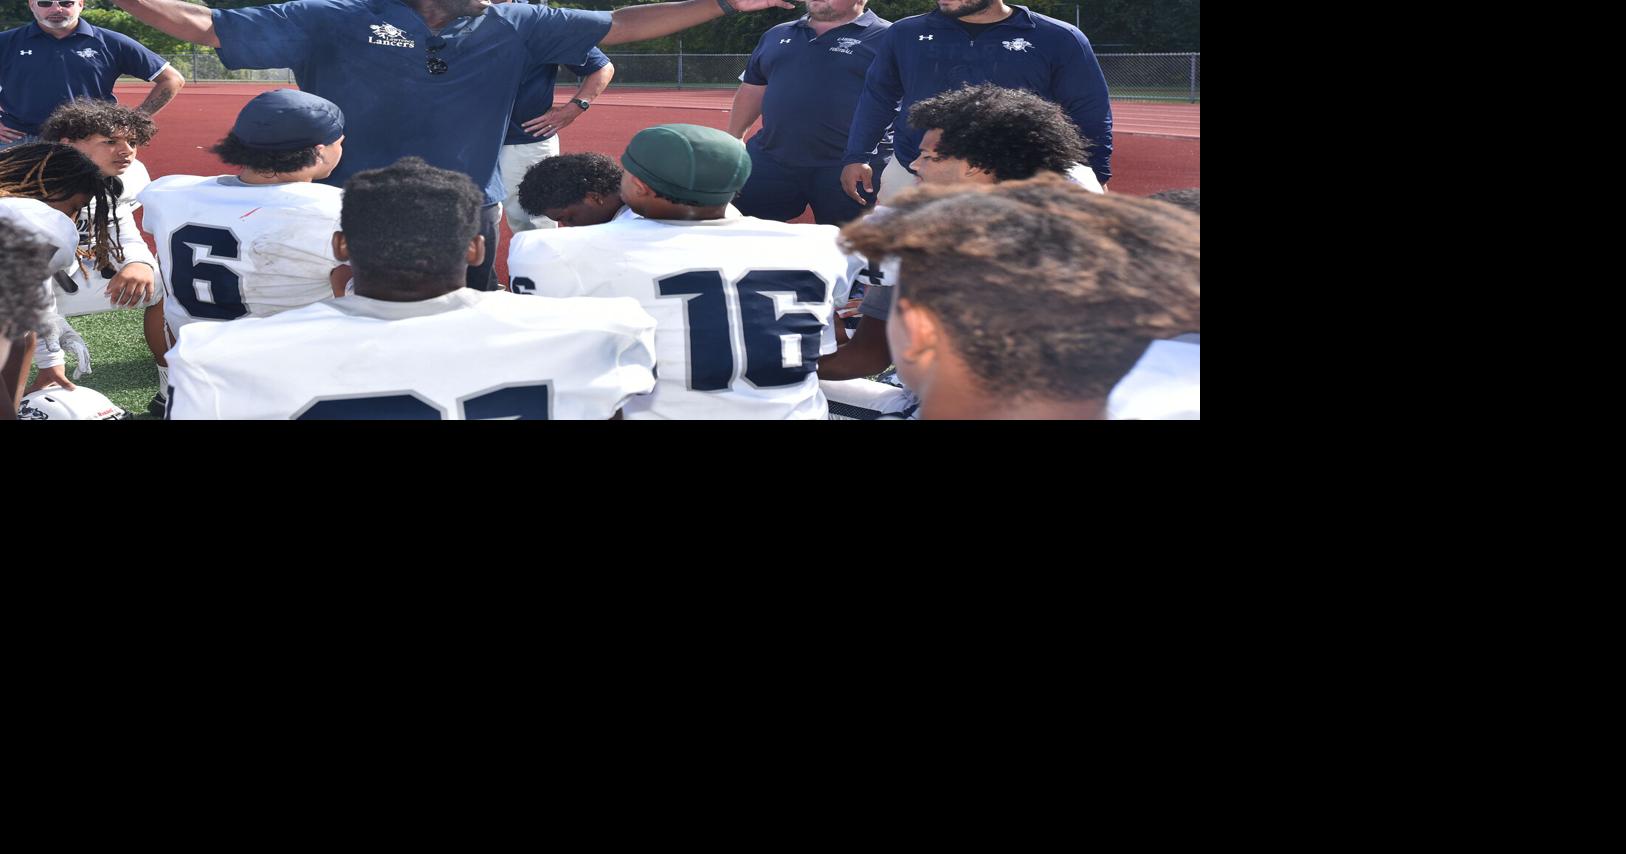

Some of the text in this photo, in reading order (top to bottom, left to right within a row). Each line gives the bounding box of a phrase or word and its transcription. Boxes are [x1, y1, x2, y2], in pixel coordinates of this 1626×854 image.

[368, 36, 415, 48] Lancers
[168, 221, 252, 321] 6
[653, 267, 829, 392] 16
